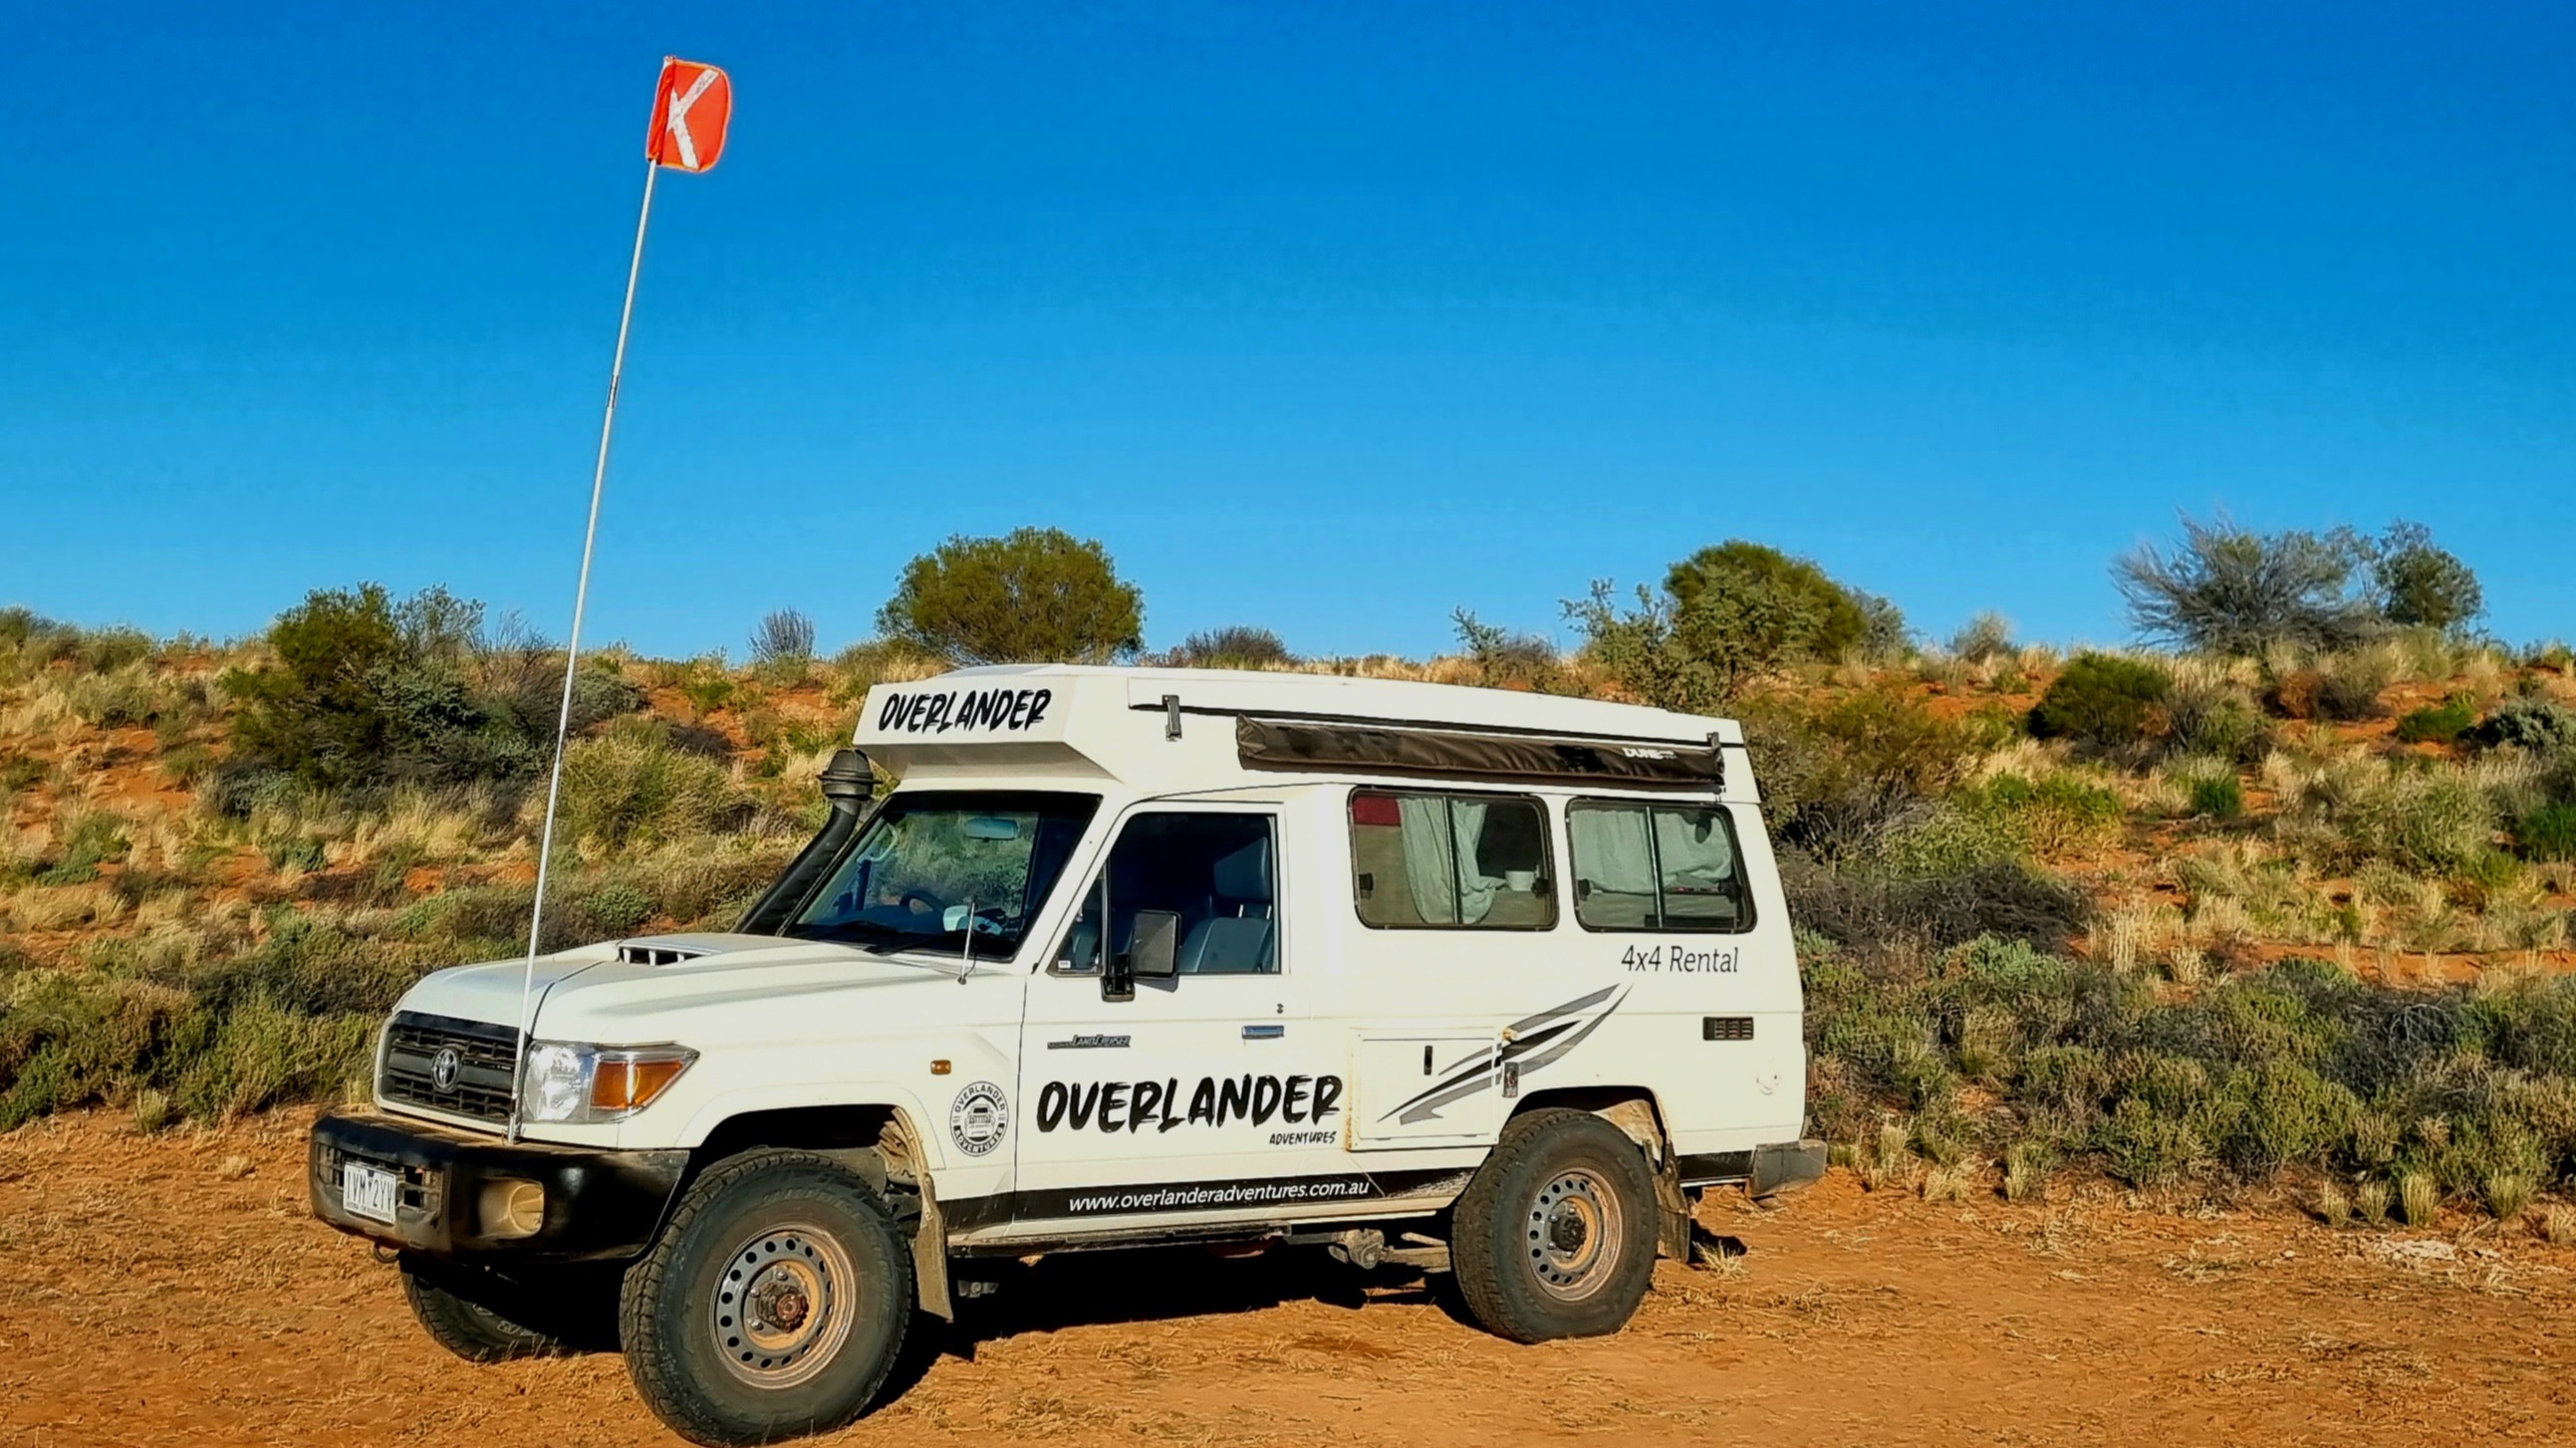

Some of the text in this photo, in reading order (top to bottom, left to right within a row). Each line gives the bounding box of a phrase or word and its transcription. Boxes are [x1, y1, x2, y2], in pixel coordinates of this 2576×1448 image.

[878, 688, 1052, 734] OVERLANDER
[1621, 944, 1739, 973] 4x4 Rental
[954, 1085, 1006, 1113] OVERLANDER
[1037, 1074, 1344, 1134] OVERLANDER
[1269, 1131, 1337, 1145] ADVENTURES
[1069, 1180, 1371, 1212] www.overlanderadventures.com.au
